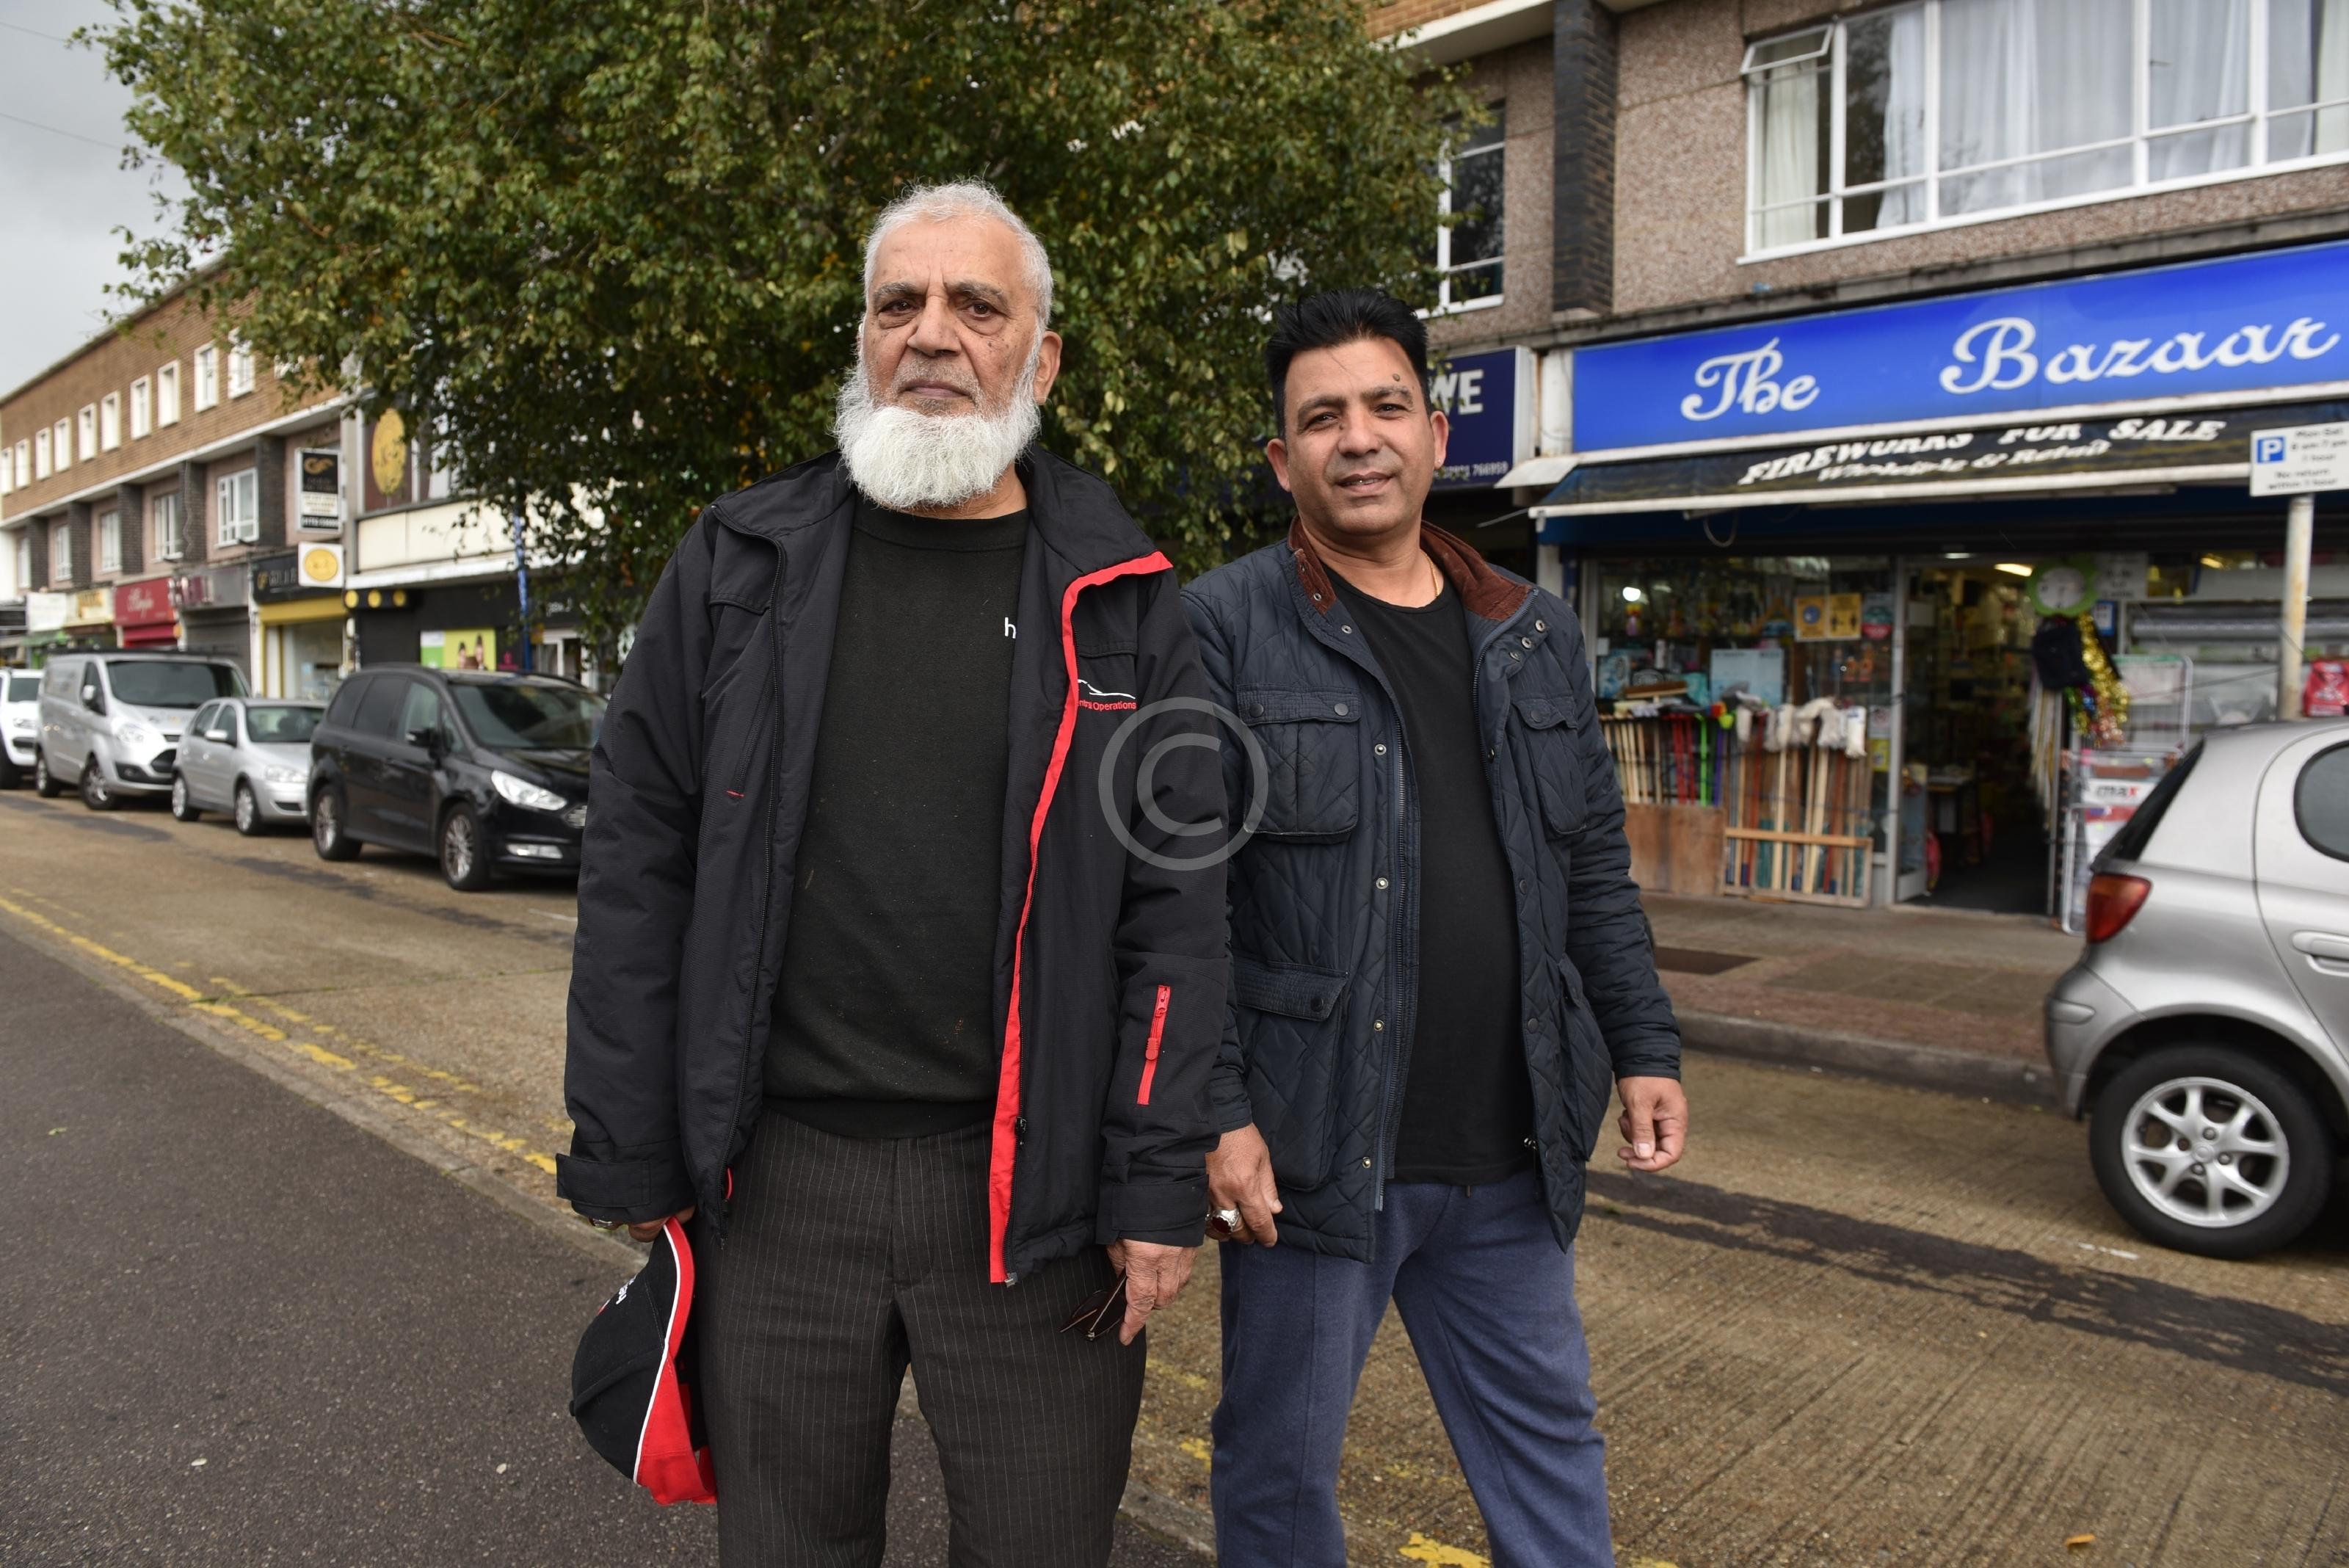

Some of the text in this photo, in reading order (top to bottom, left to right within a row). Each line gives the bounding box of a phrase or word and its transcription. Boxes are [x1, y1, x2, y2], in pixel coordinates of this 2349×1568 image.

[1680, 316, 2340, 422] The Bazaar
[2108, 418, 2227, 441] SALE
[2261, 439, 2283, 462] P
[1004, 617, 1017, 639] h
[1092, 700, 1137, 712] Operations
